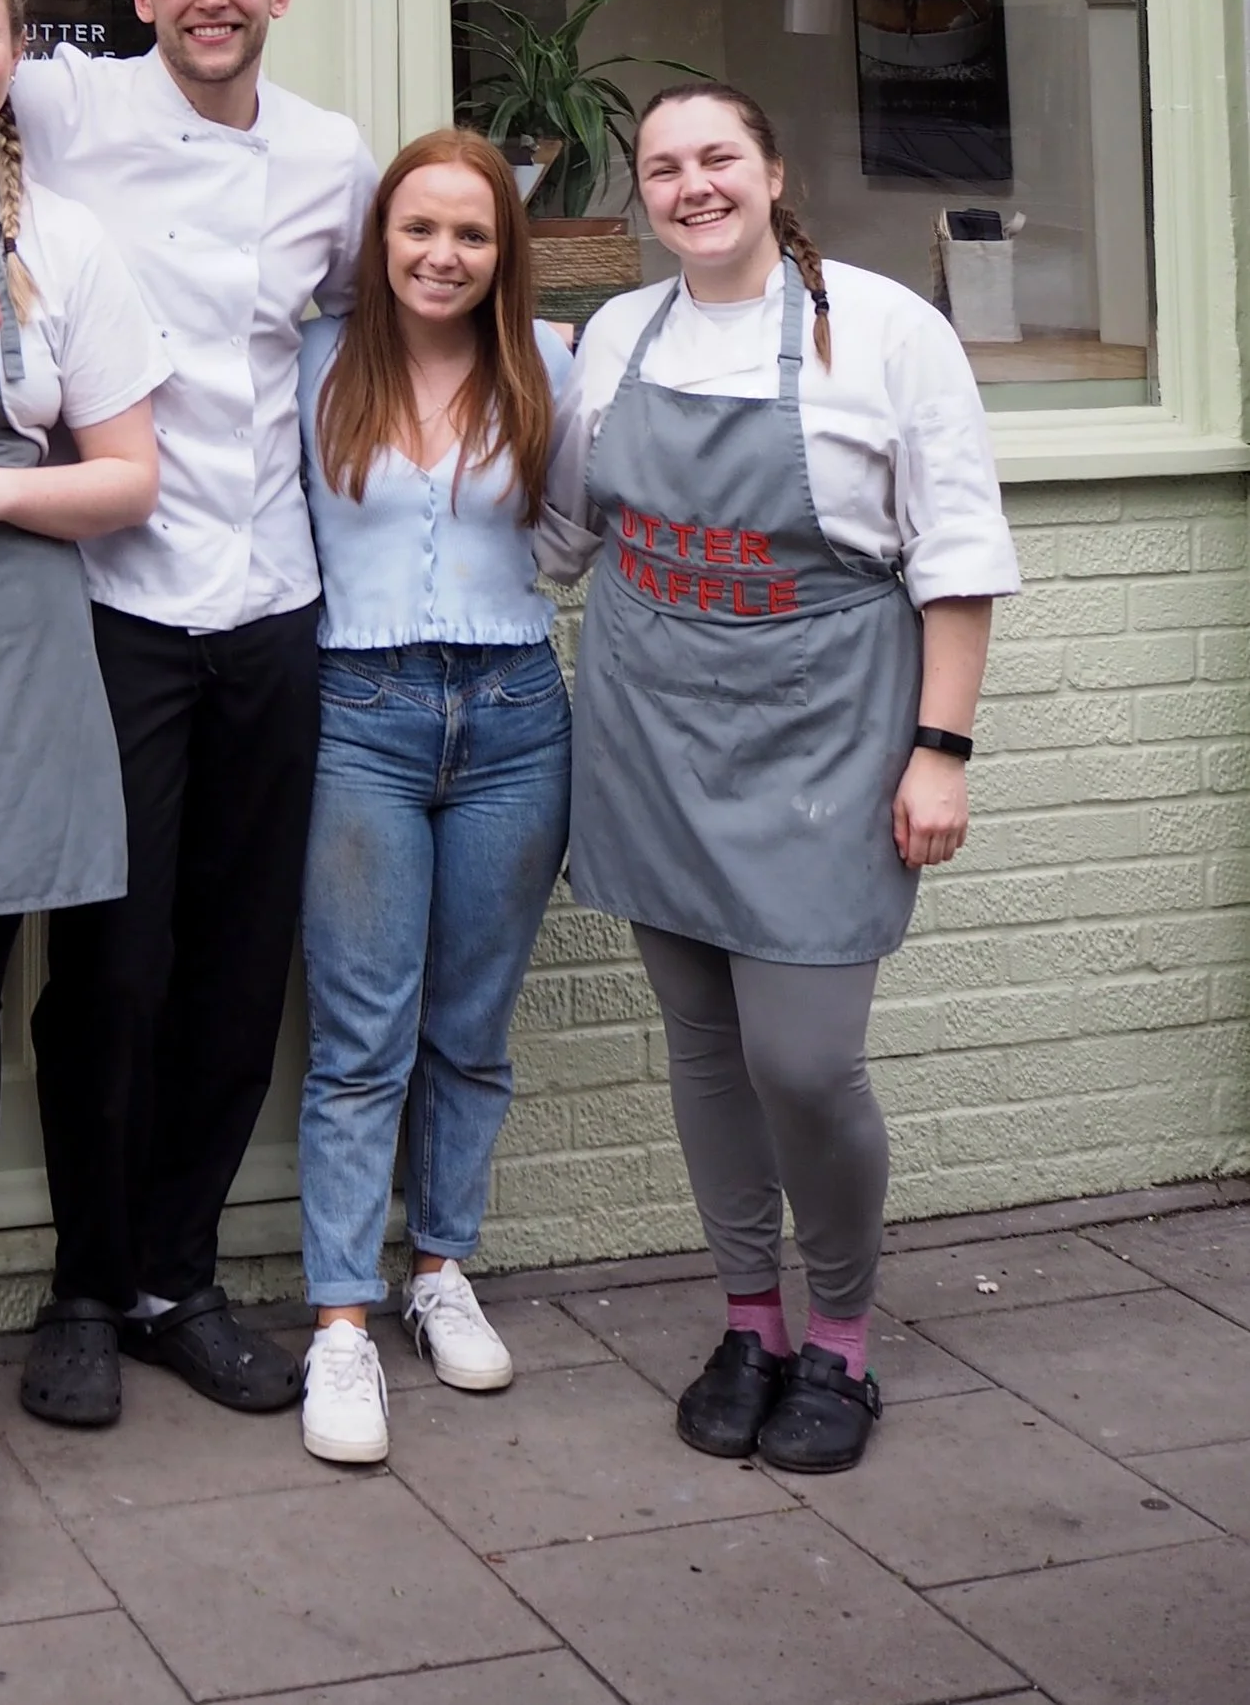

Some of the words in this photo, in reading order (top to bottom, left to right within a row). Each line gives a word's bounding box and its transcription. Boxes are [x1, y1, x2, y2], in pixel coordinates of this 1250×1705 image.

[22, 23, 106, 43] UTTER
[618, 503, 775, 566] UTTER
[618, 541, 800, 616] WAFFLE
